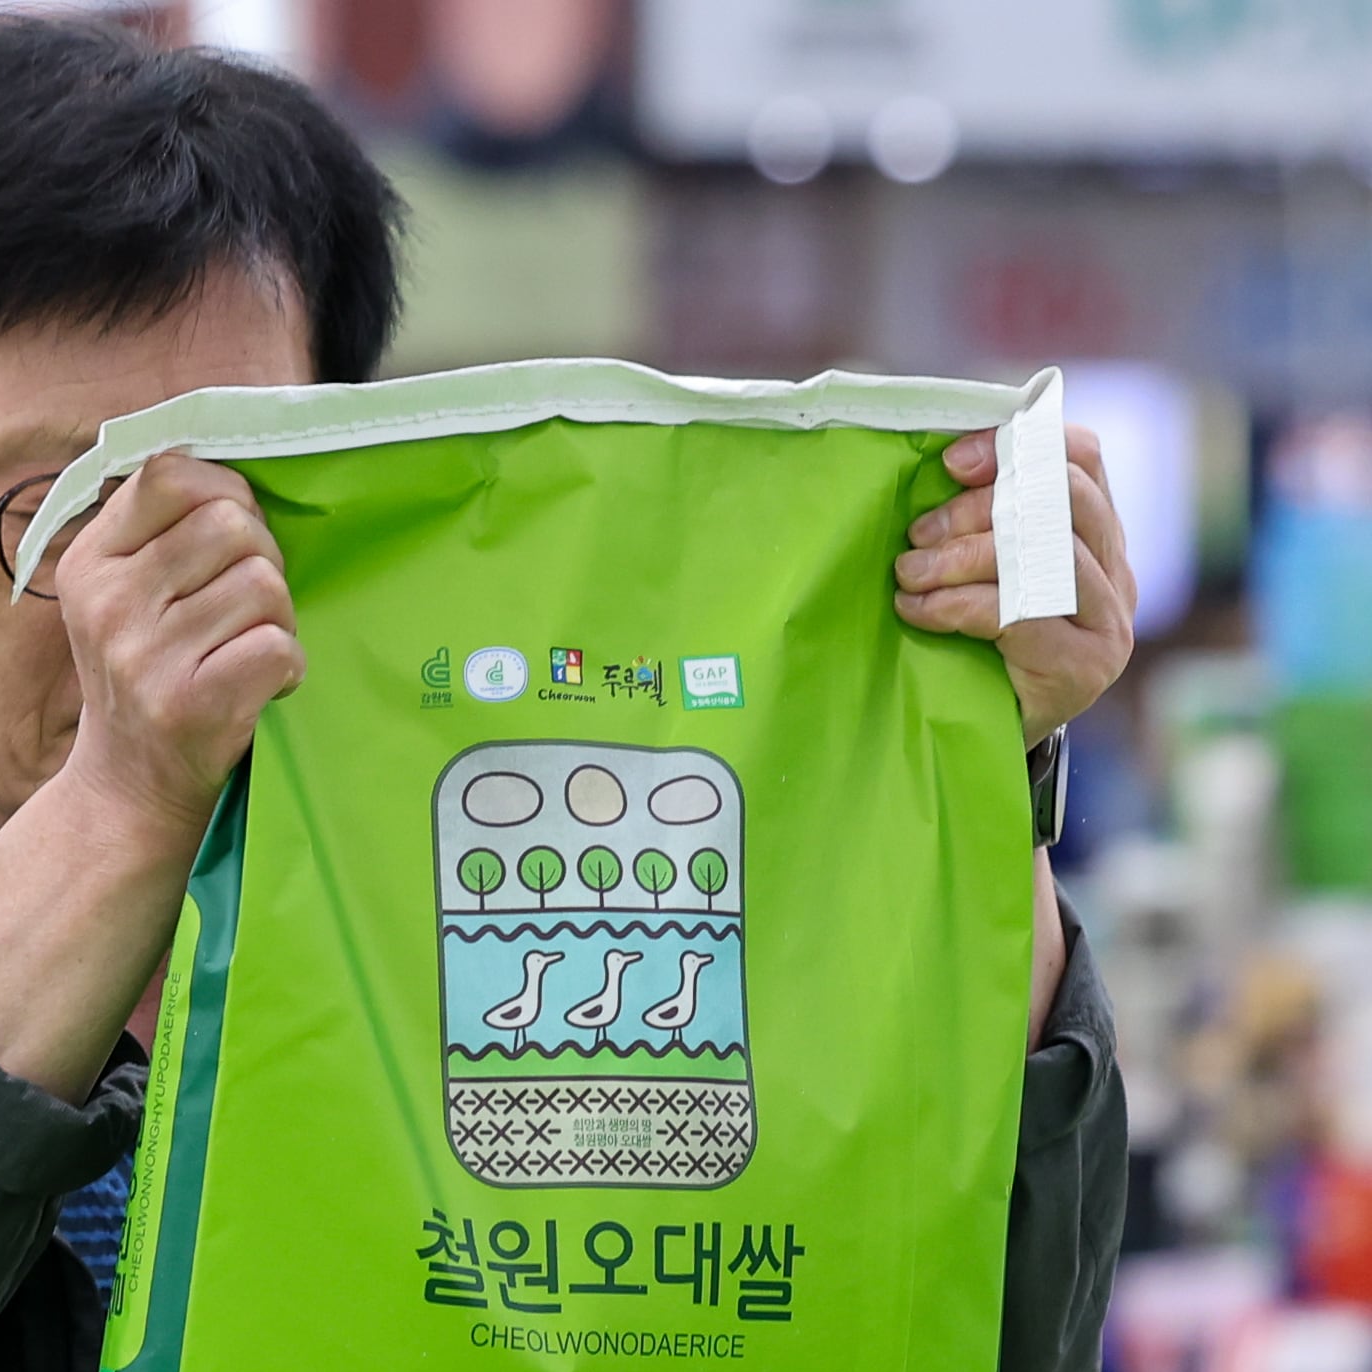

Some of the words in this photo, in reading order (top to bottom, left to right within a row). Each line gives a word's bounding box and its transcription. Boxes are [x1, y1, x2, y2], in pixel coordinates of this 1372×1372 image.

[693, 667, 727, 680] GAP
[538, 689, 596, 704] Cheorwon
[609, 1117, 639, 1132] 생명의
[128, 971, 182, 1294] CHEOLWONNONGHYUPODAERICE
[620, 1133, 652, 1147] 오대쌀
[416, 1208, 805, 1321] 철원오대쌀
[471, 1323, 745, 1358] CHEOLWONODAERICE
